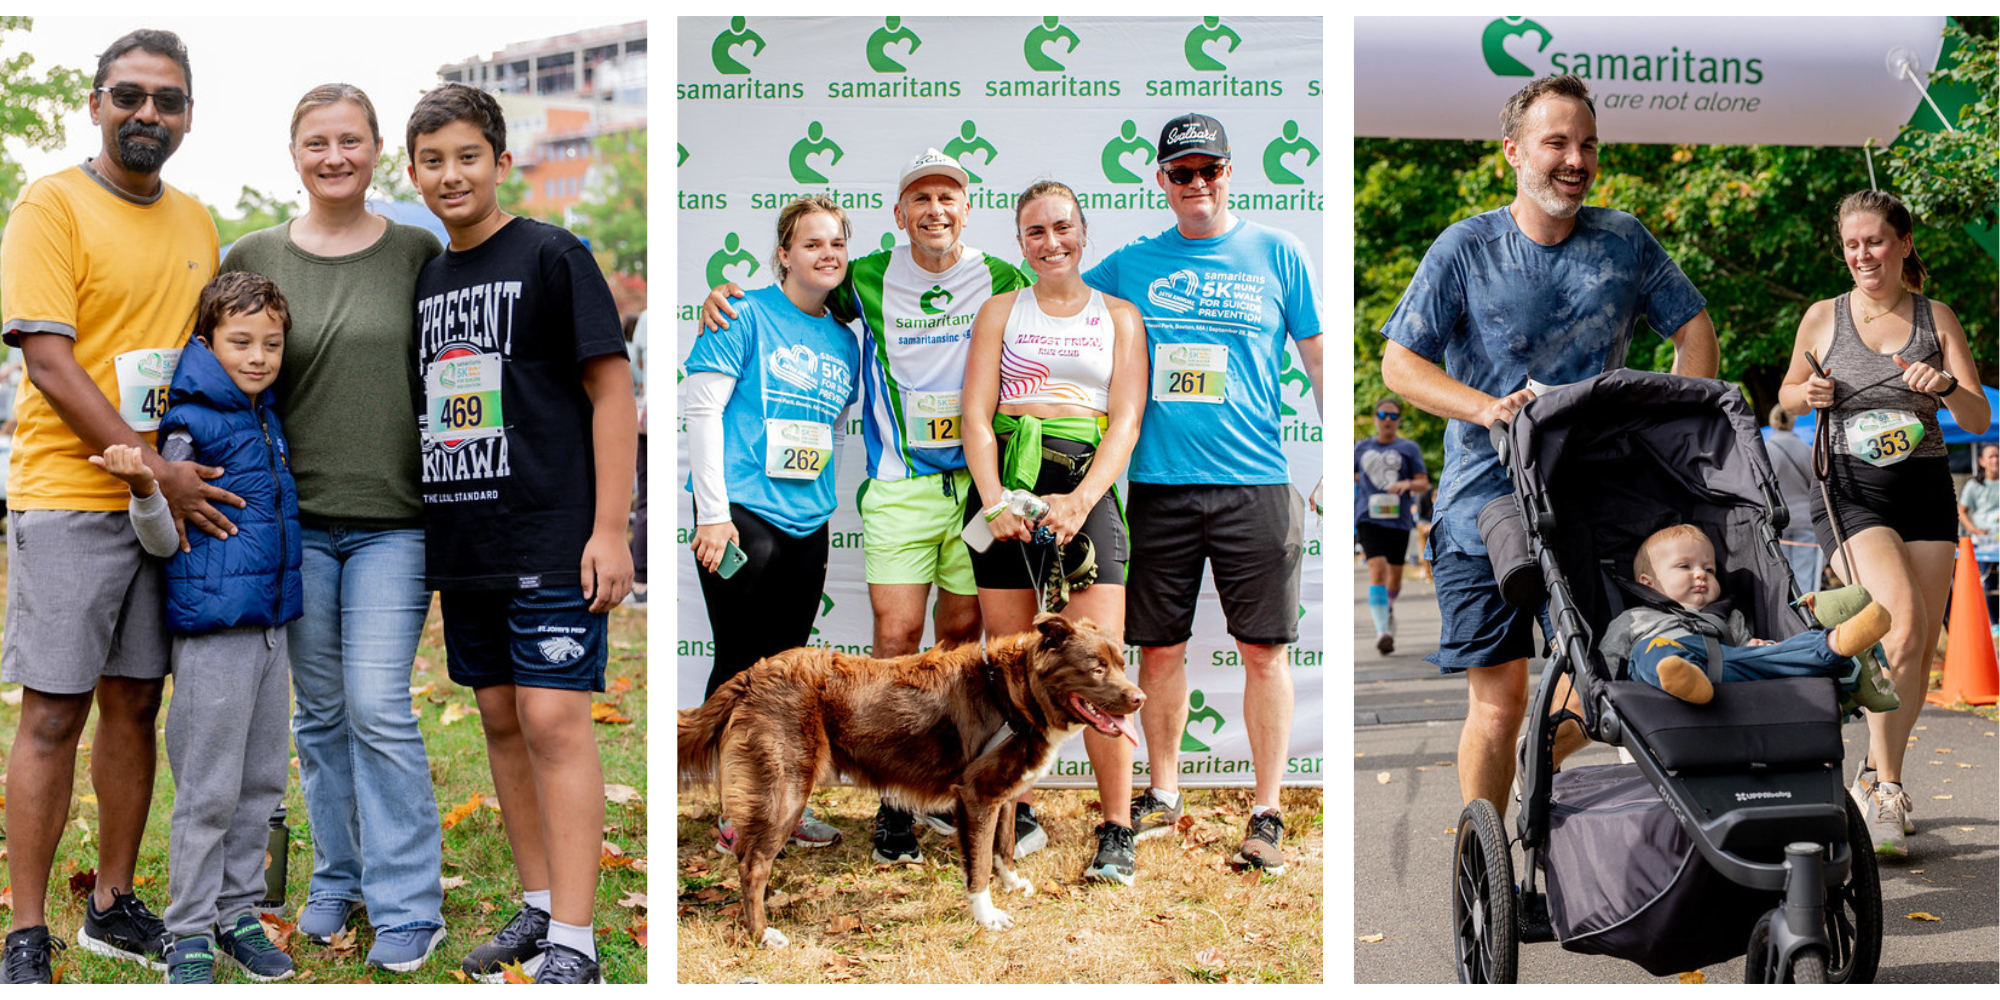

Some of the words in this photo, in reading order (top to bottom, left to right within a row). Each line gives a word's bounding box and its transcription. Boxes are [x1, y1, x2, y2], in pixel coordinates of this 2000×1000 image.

[1550, 46, 1764, 86] samaritans
[676, 77, 804, 100] samaritans
[827, 76, 961, 98] samaritans
[984, 75, 1121, 98] samaritans
[1145, 75, 1284, 97] samaritans
[1604, 93, 1644, 109] are
[1649, 92, 1688, 111] not
[1694, 91, 1761, 114] alone
[1203, 271, 1266, 285] samaritans
[1201, 281, 1232, 299] 5K
[1232, 292, 1263, 303] WALK
[1197, 308, 1262, 324] PREVENTION
[1199, 298, 1220, 308] FOR
[1222, 299, 1262, 314] SUICIDE
[418, 281, 523, 358] PRESENT
[1015, 334, 1062, 347] ALMOST
[822, 361, 844, 385] 5K
[1168, 371, 1206, 395] 261
[141, 388, 169, 419] 45
[440, 395, 482, 429] 469
[927, 418, 954, 441] 12
[1867, 429, 1911, 460] 353
[421, 436, 511, 483] KINAWA
[783, 447, 820, 472] 262
[423, 494, 438, 503] THE
[454, 489, 499, 502] STANDARD
[1658, 784, 1687, 827] RIDGE
